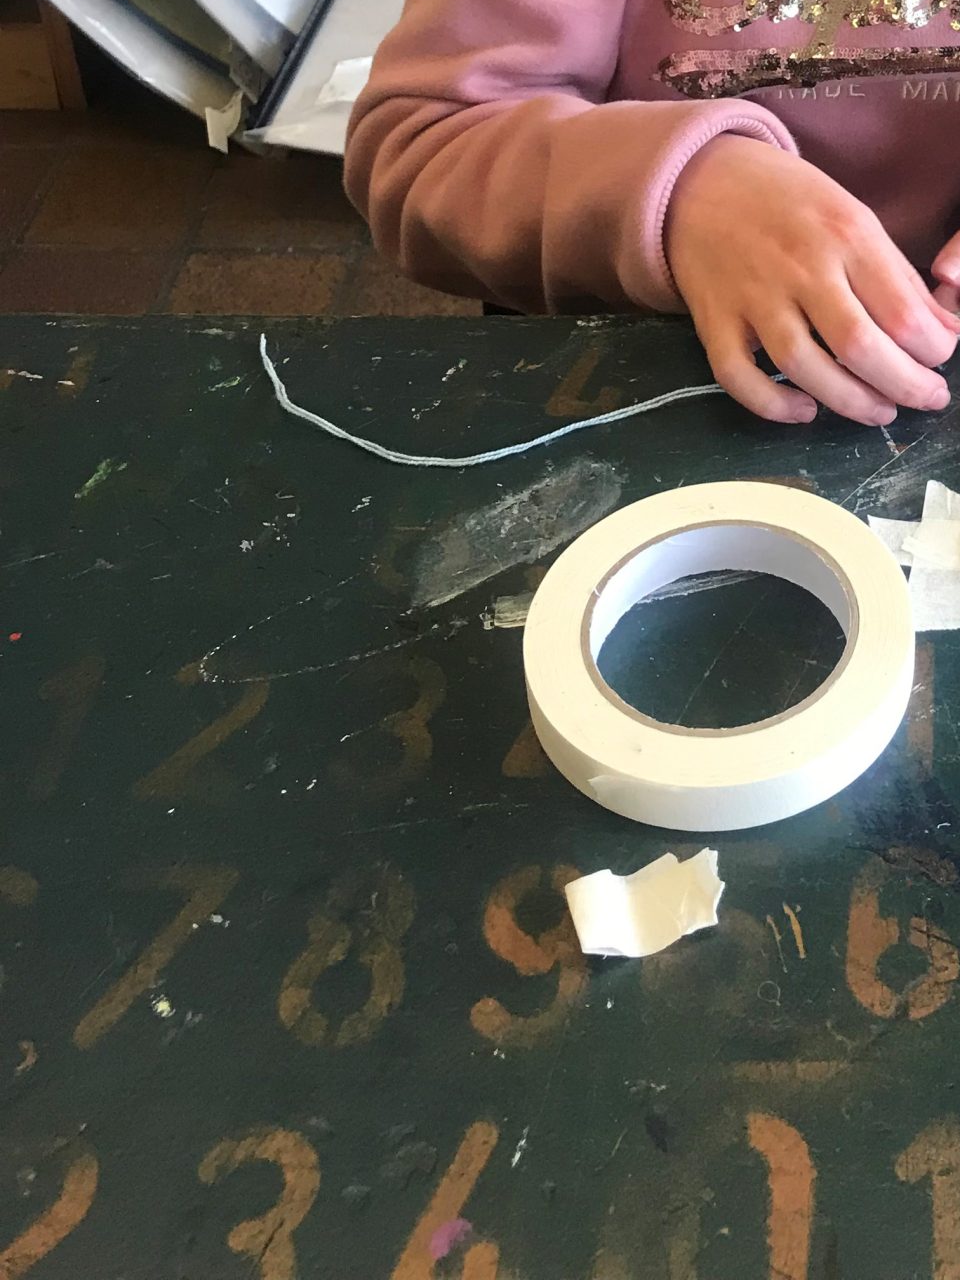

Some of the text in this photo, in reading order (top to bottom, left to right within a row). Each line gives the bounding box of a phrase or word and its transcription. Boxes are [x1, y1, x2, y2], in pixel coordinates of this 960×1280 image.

[777, 81, 866, 100] RADE
[470, 863, 592, 1050] 9
[846, 845, 960, 1021] 6
